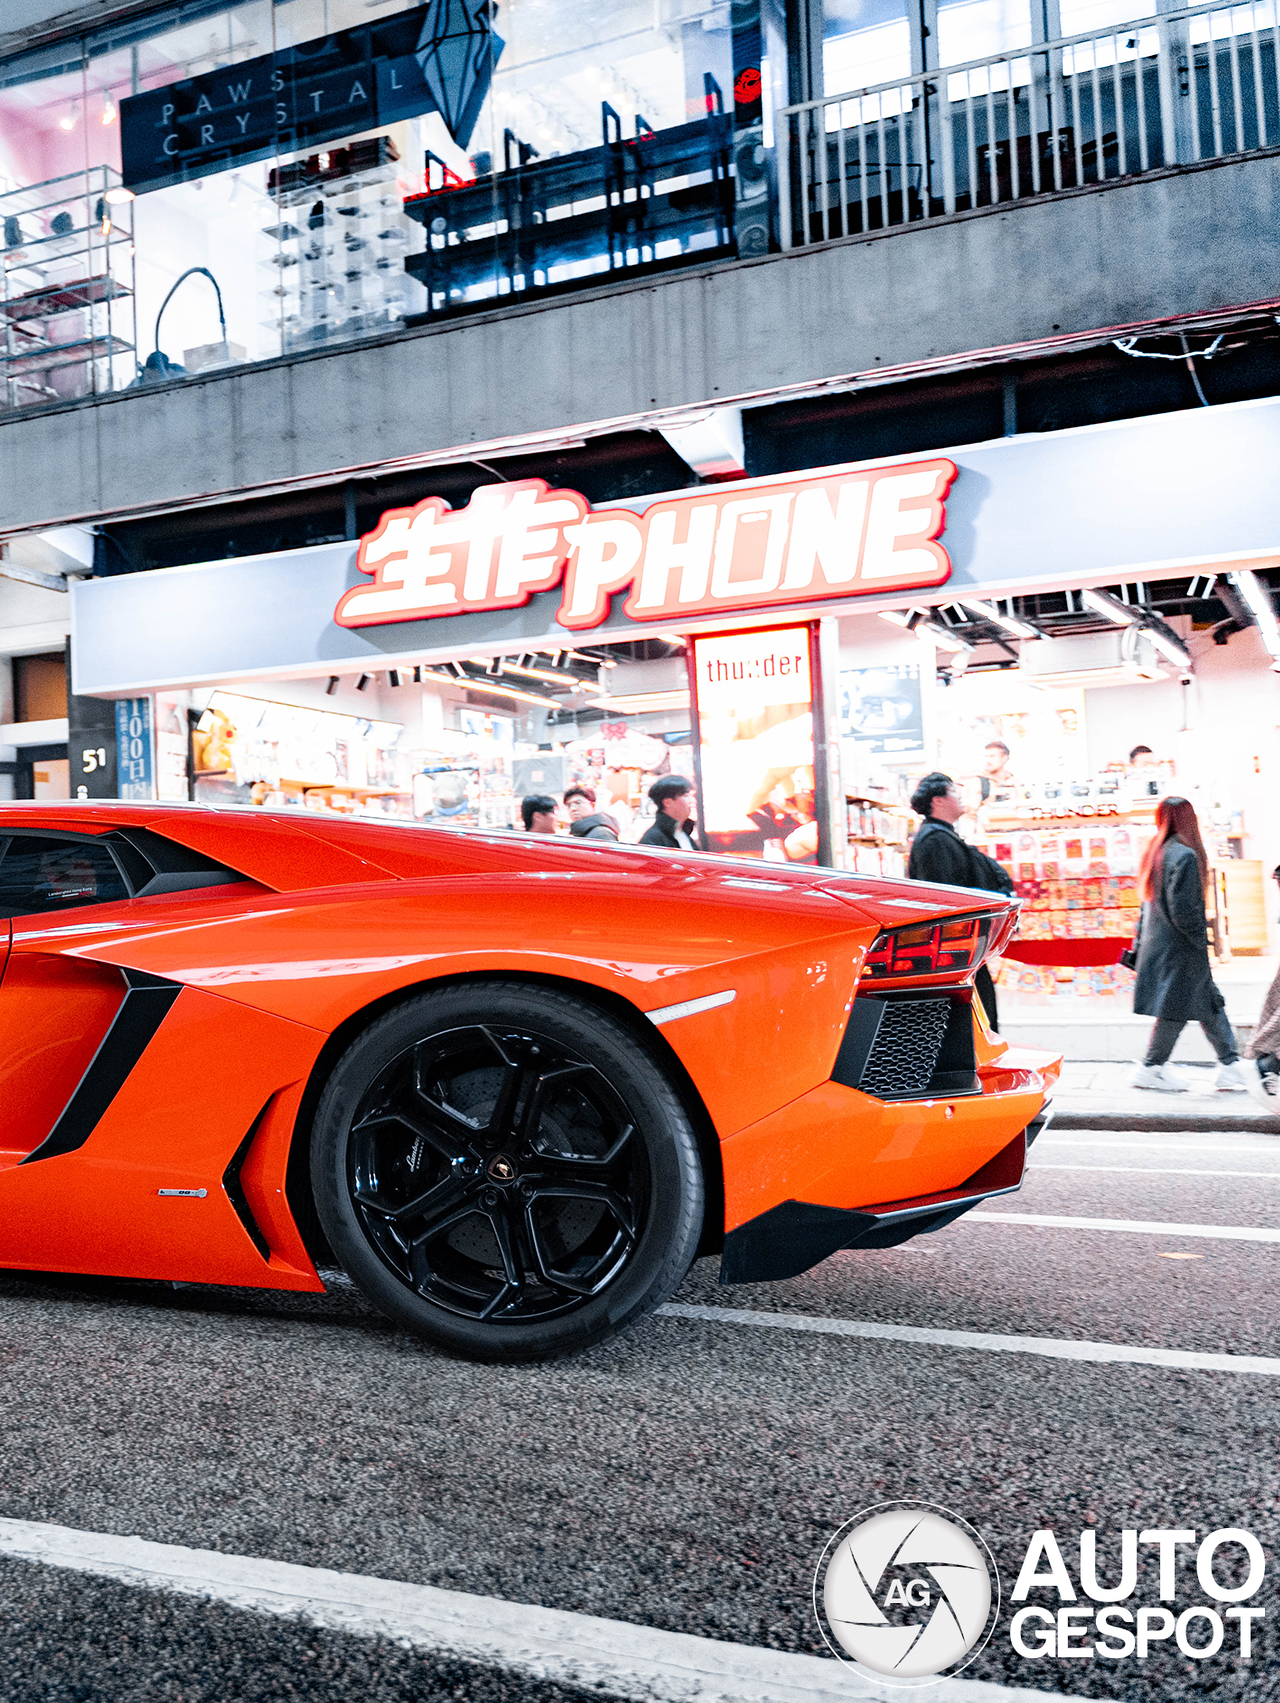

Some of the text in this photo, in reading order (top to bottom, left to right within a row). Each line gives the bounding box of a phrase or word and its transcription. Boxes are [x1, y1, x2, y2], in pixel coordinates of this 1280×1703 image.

[162, 69, 285, 125] PAWS
[162, 69, 403, 156] CRYSTAL
[563, 469, 945, 617] PHONE
[82, 748, 106, 773] 51
